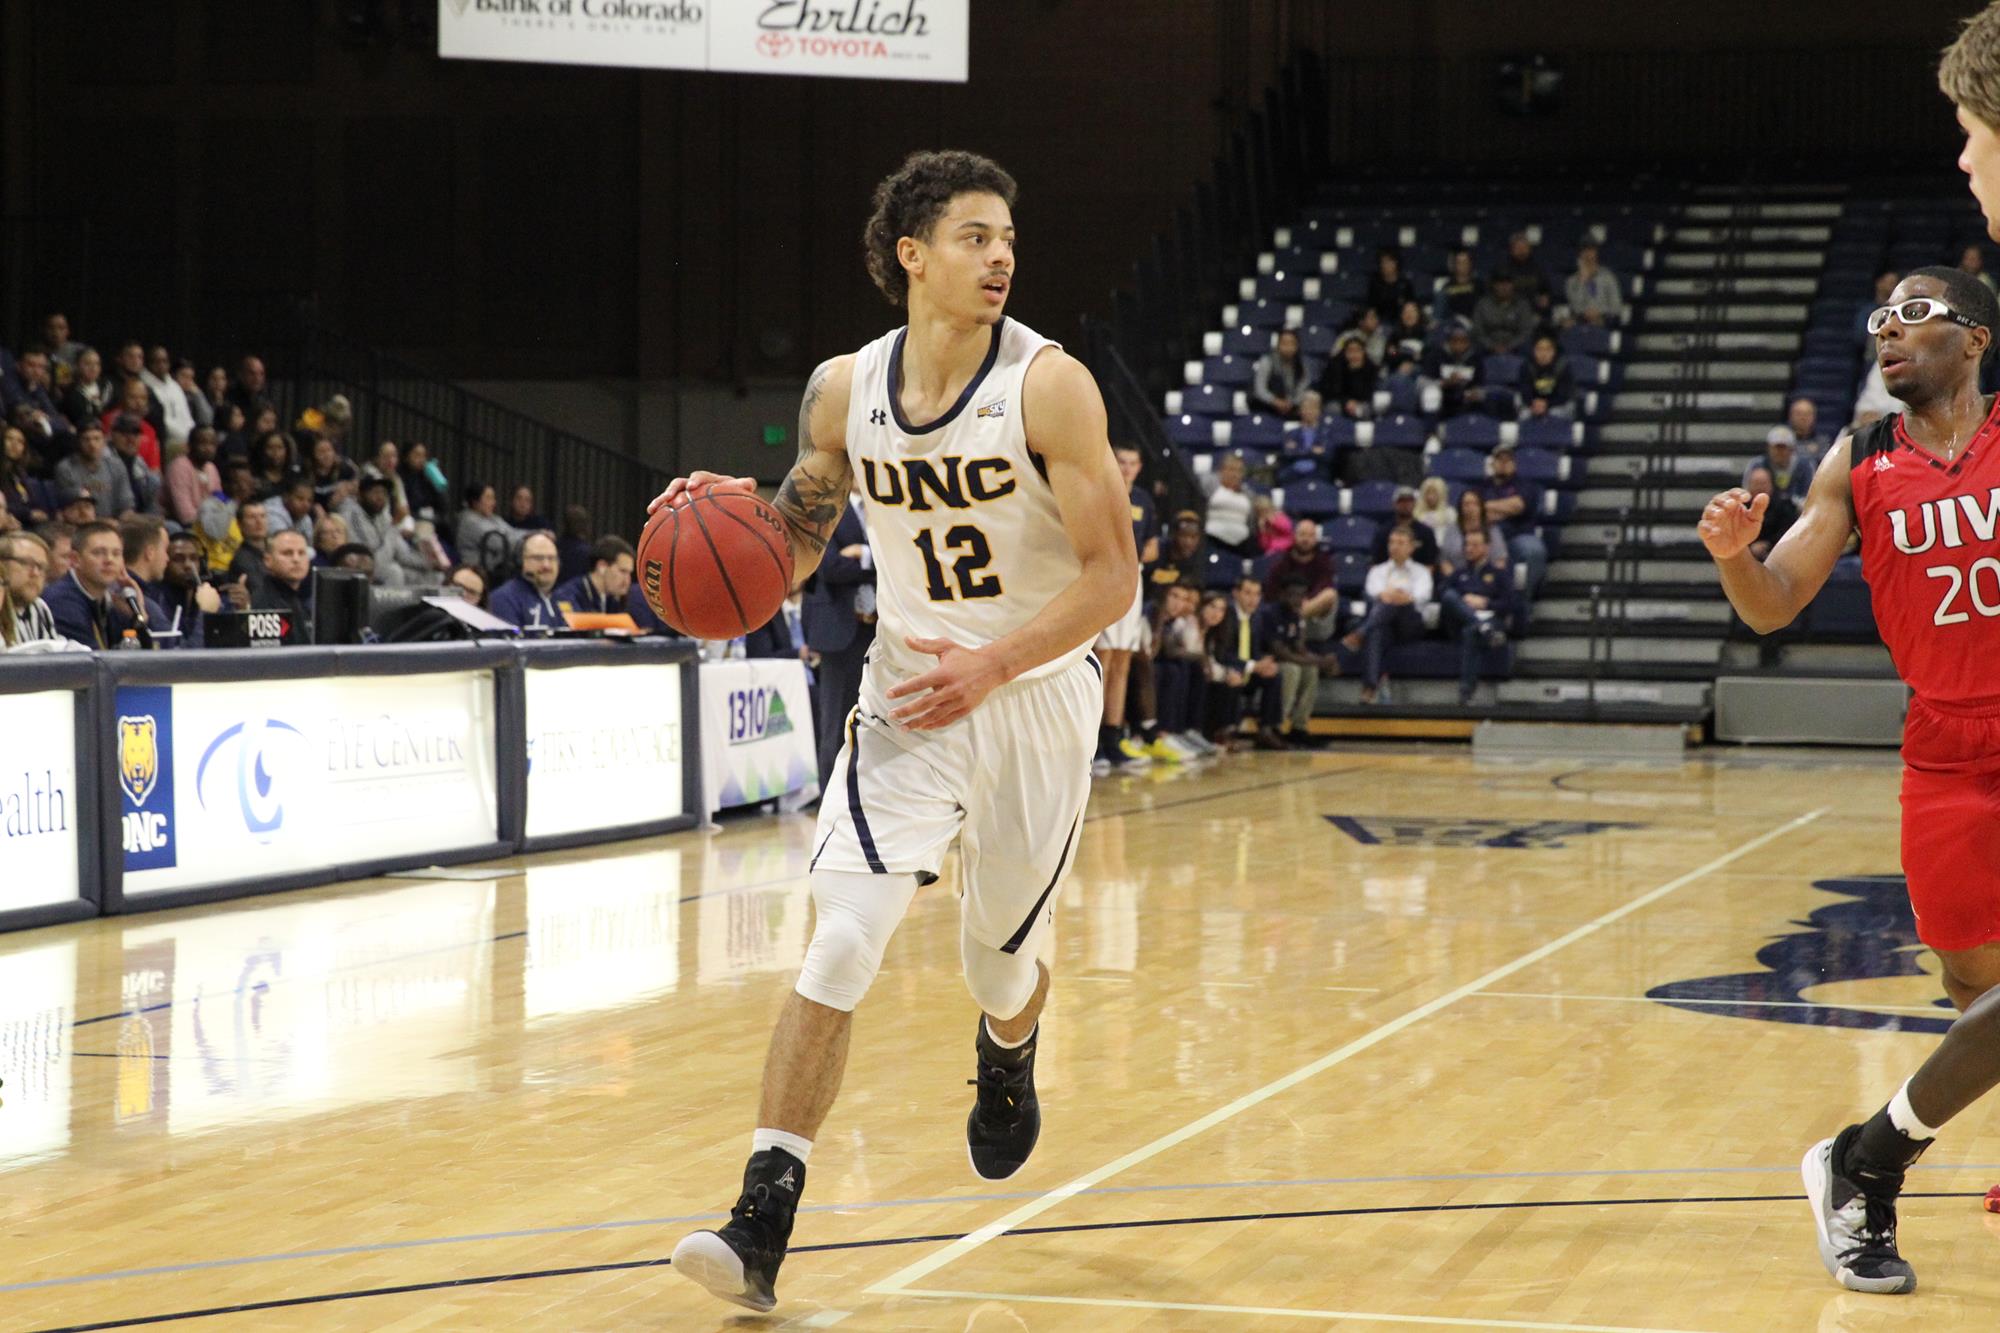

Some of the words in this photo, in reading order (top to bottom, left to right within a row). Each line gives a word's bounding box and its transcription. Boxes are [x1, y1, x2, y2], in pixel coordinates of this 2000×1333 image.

[583, 0, 703, 23] Colorado
[757, 0, 929, 36] Ehrlich
[800, 38, 888, 59] TOYOTA
[860, 455, 1016, 511] UNC
[912, 524, 1004, 602] 12
[1925, 557, 2000, 627] 20
[248, 613, 282, 638] POSS
[729, 688, 766, 740] 1310
[0, 769, 68, 838] alth
